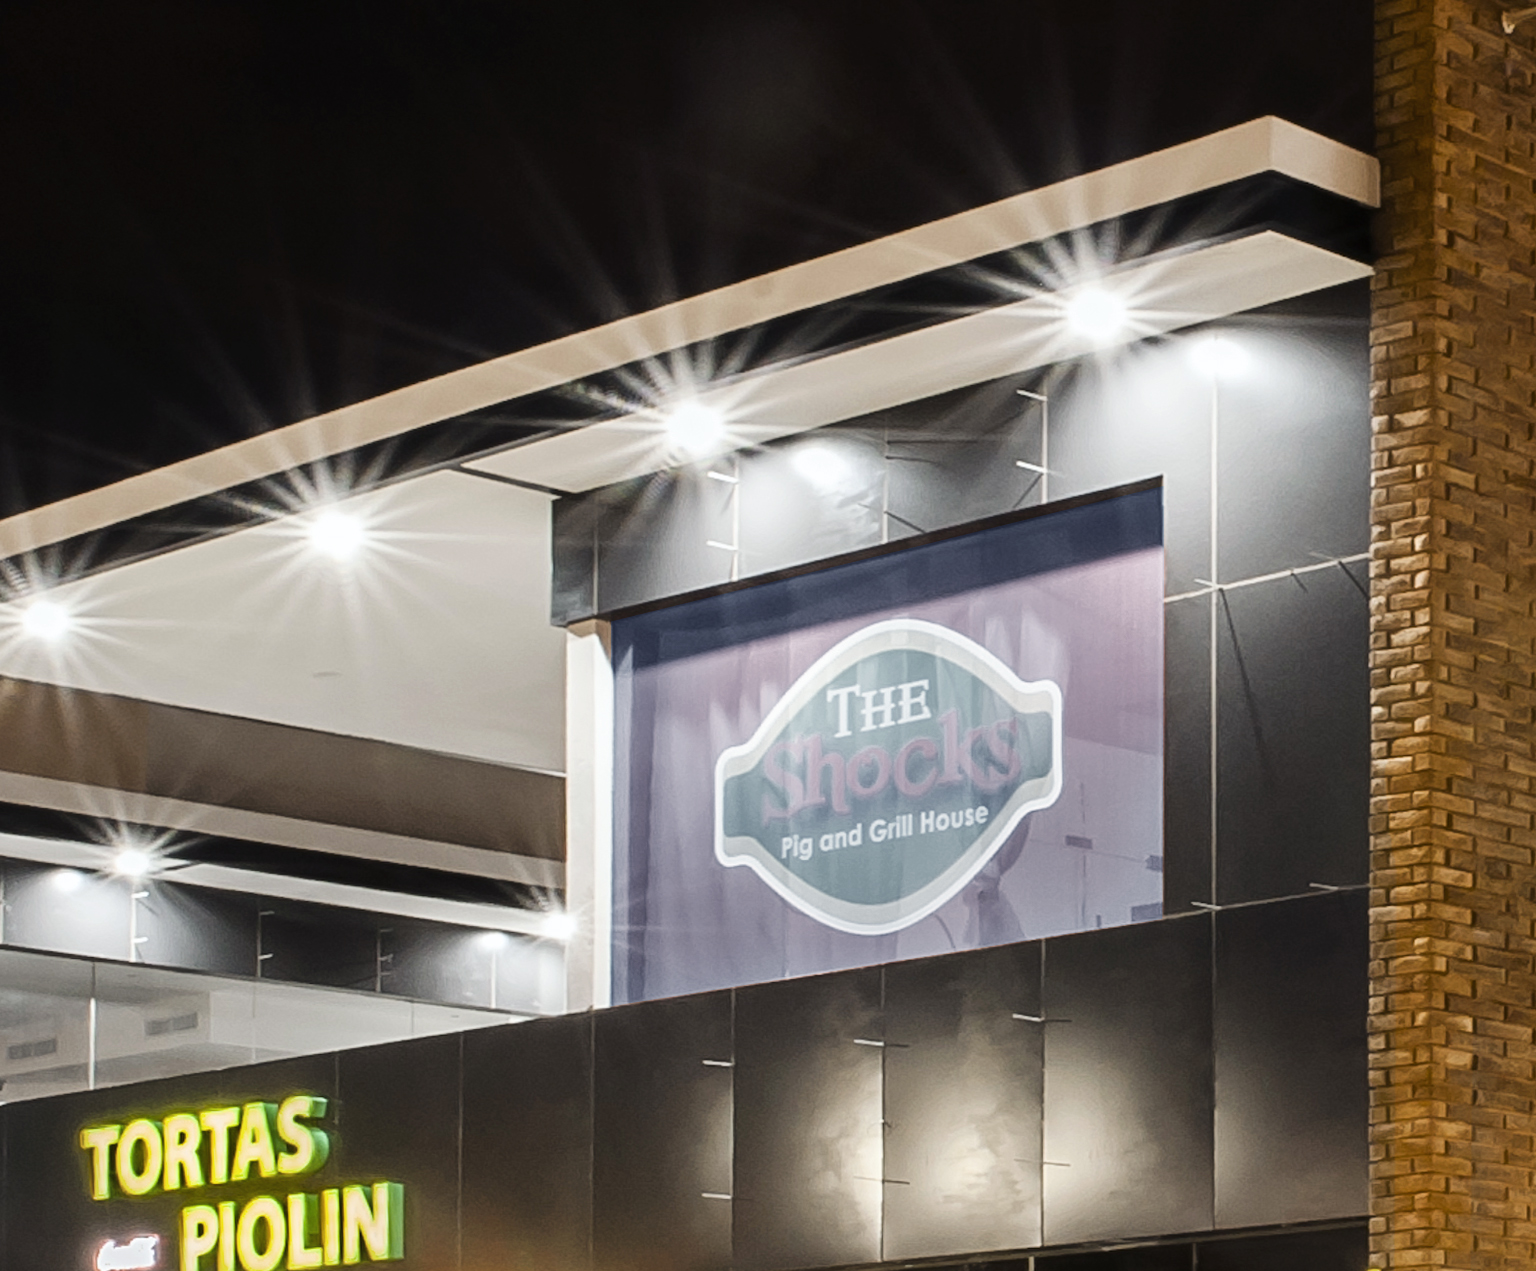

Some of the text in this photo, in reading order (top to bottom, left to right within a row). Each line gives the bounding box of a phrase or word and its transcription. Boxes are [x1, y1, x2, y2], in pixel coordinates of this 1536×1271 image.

[826, 679, 932, 738] THE
[781, 805, 989, 861] Pig and Grill House
[80, 1094, 330, 1202] TORTAS
